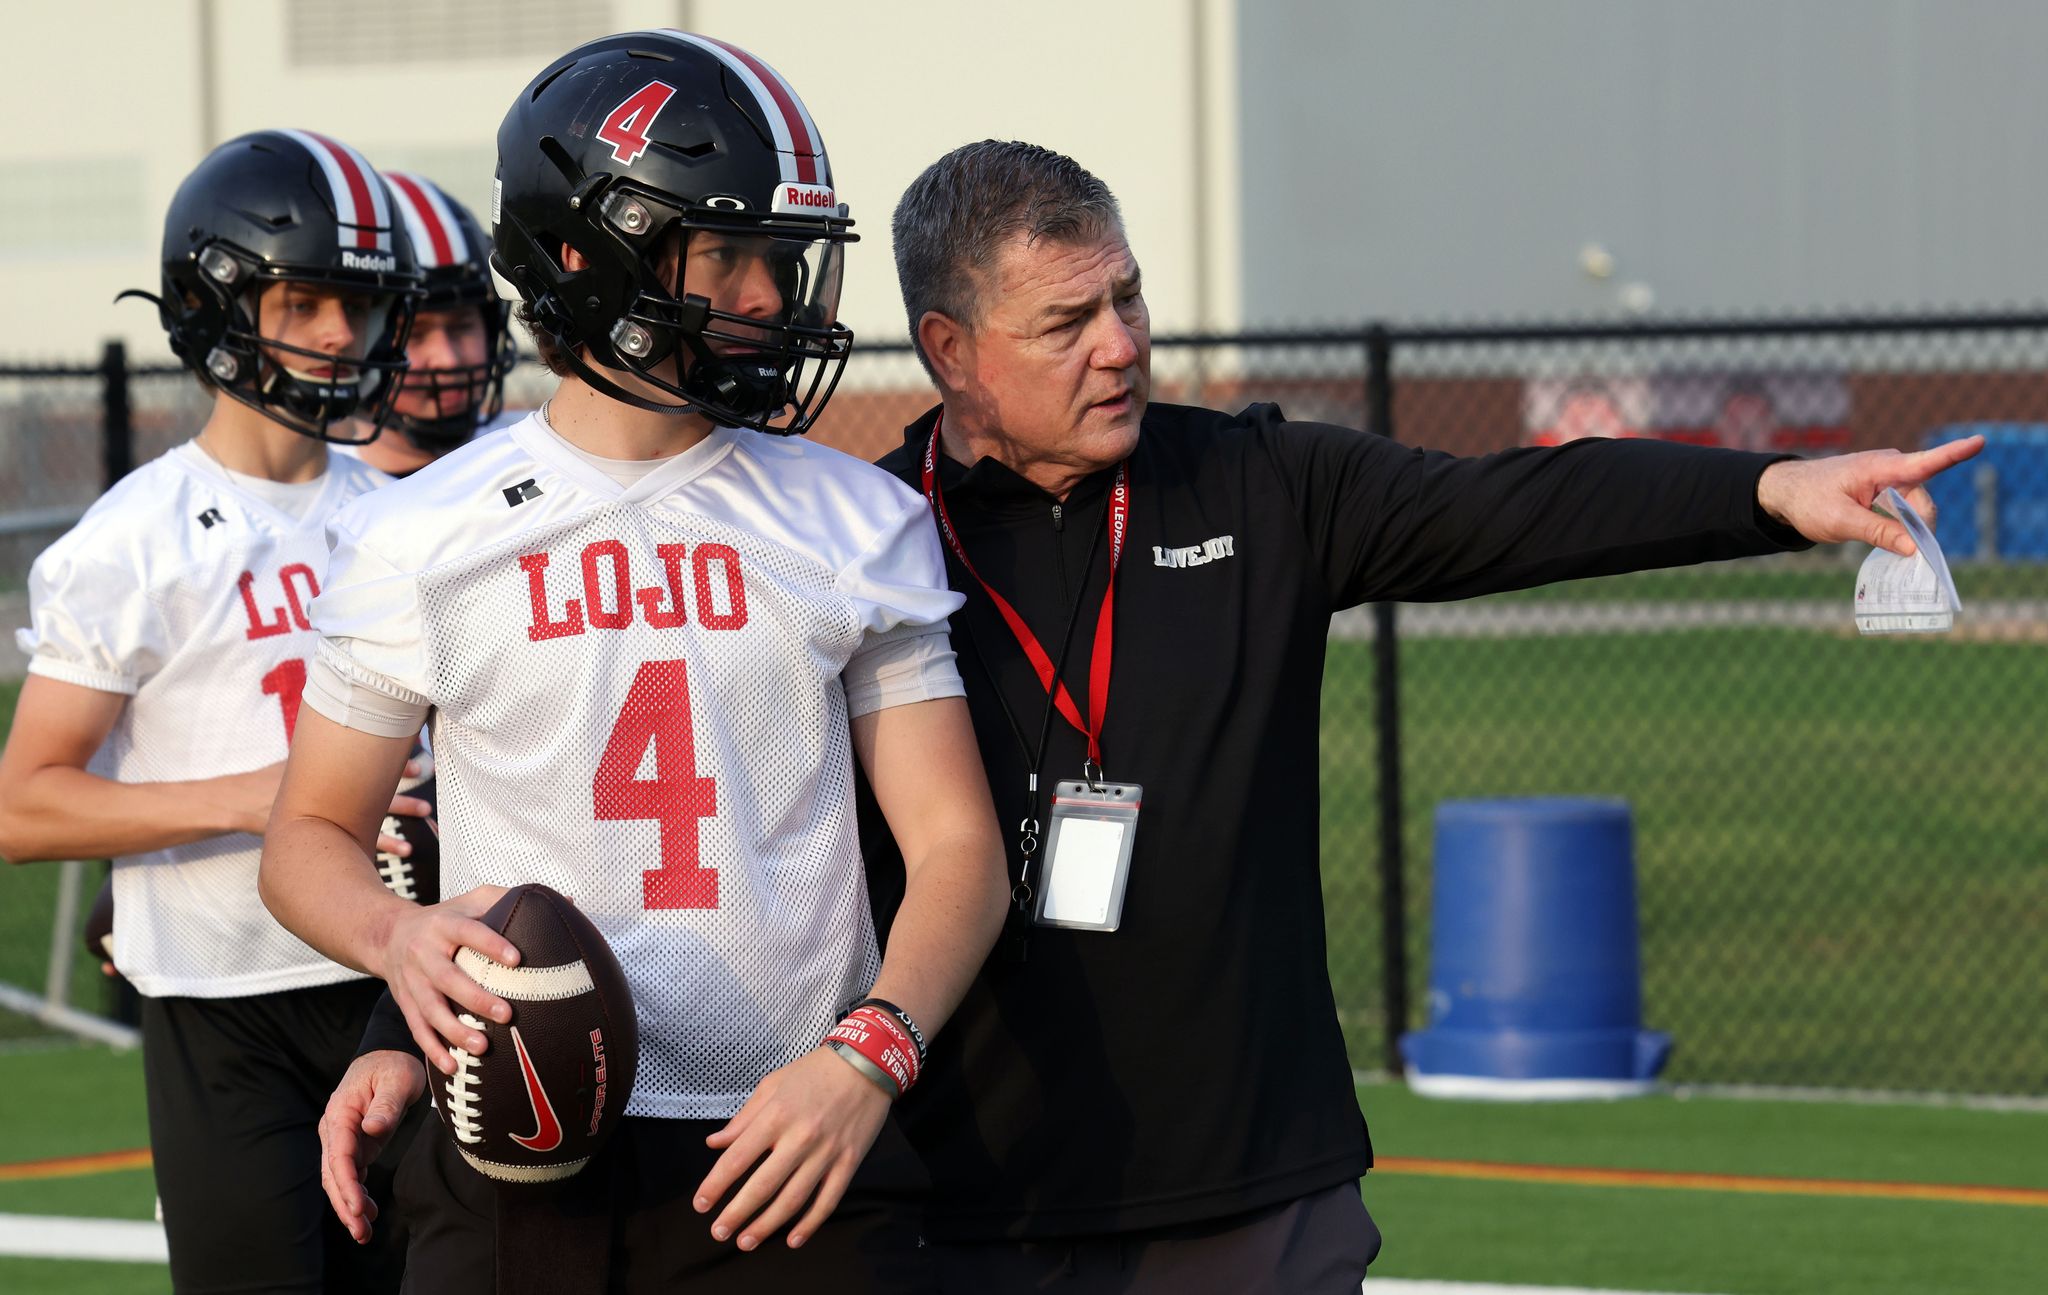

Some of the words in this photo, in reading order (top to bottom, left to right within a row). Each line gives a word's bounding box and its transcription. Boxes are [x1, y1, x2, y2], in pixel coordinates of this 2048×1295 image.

[596, 80, 677, 166] 4
[786, 187, 835, 209] Riddell
[342, 251, 396, 272] Riddell
[1152, 535, 1234, 568] LOVEJOY
[519, 539, 748, 642] LOJO
[592, 658, 719, 910] 4
[875, 1014, 905, 1040] AXIOM
[896, 1012, 927, 1059] LEGACY
[590, 1028, 607, 1083] ELITE
